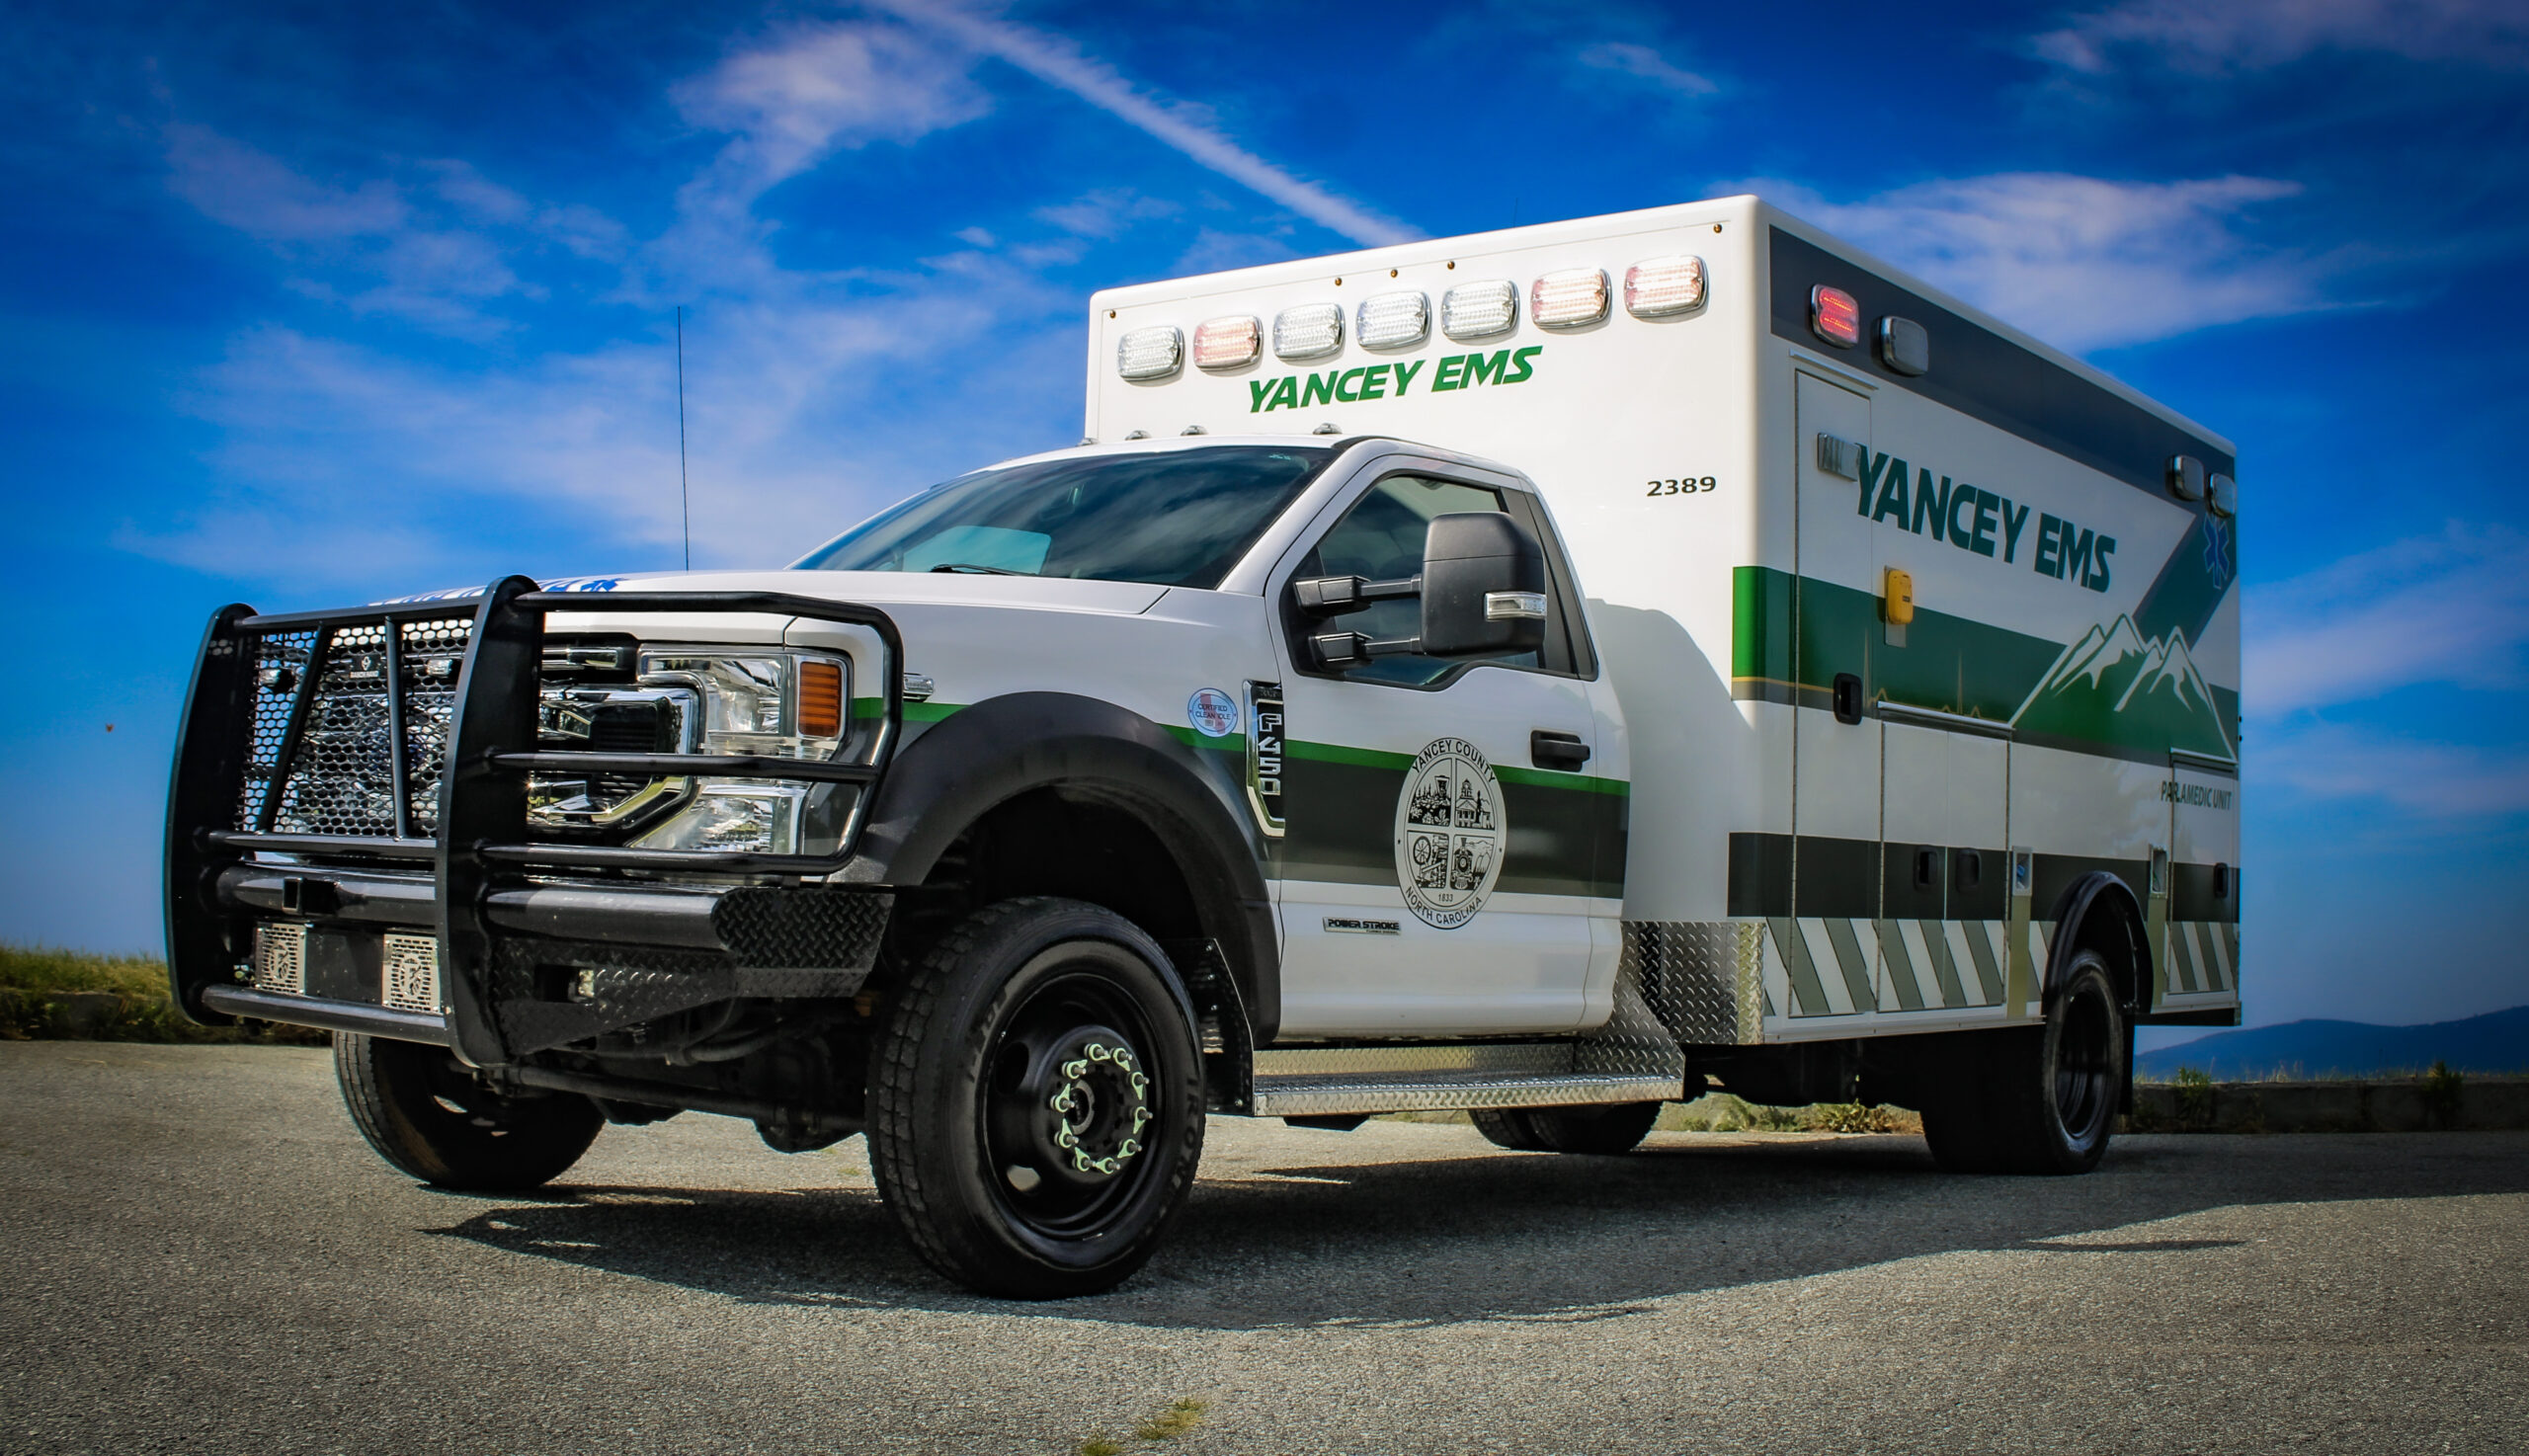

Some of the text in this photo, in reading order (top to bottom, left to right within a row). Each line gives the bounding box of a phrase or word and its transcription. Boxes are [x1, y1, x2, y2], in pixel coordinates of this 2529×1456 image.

[1250, 346, 1543, 413] YANCEY EMS
[1647, 476, 1716, 496] 2389
[1855, 443, 2116, 593] YANCEY EMS
[1195, 710, 1215, 719] CLEAN
[1412, 739, 1496, 783] YANCEY COUNTY
[2161, 780, 2232, 810] PARAMEDIC UNIT
[1405, 886, 1482, 925] NORTH CAROLINA
[1328, 919, 1400, 930] POWER STROKE
